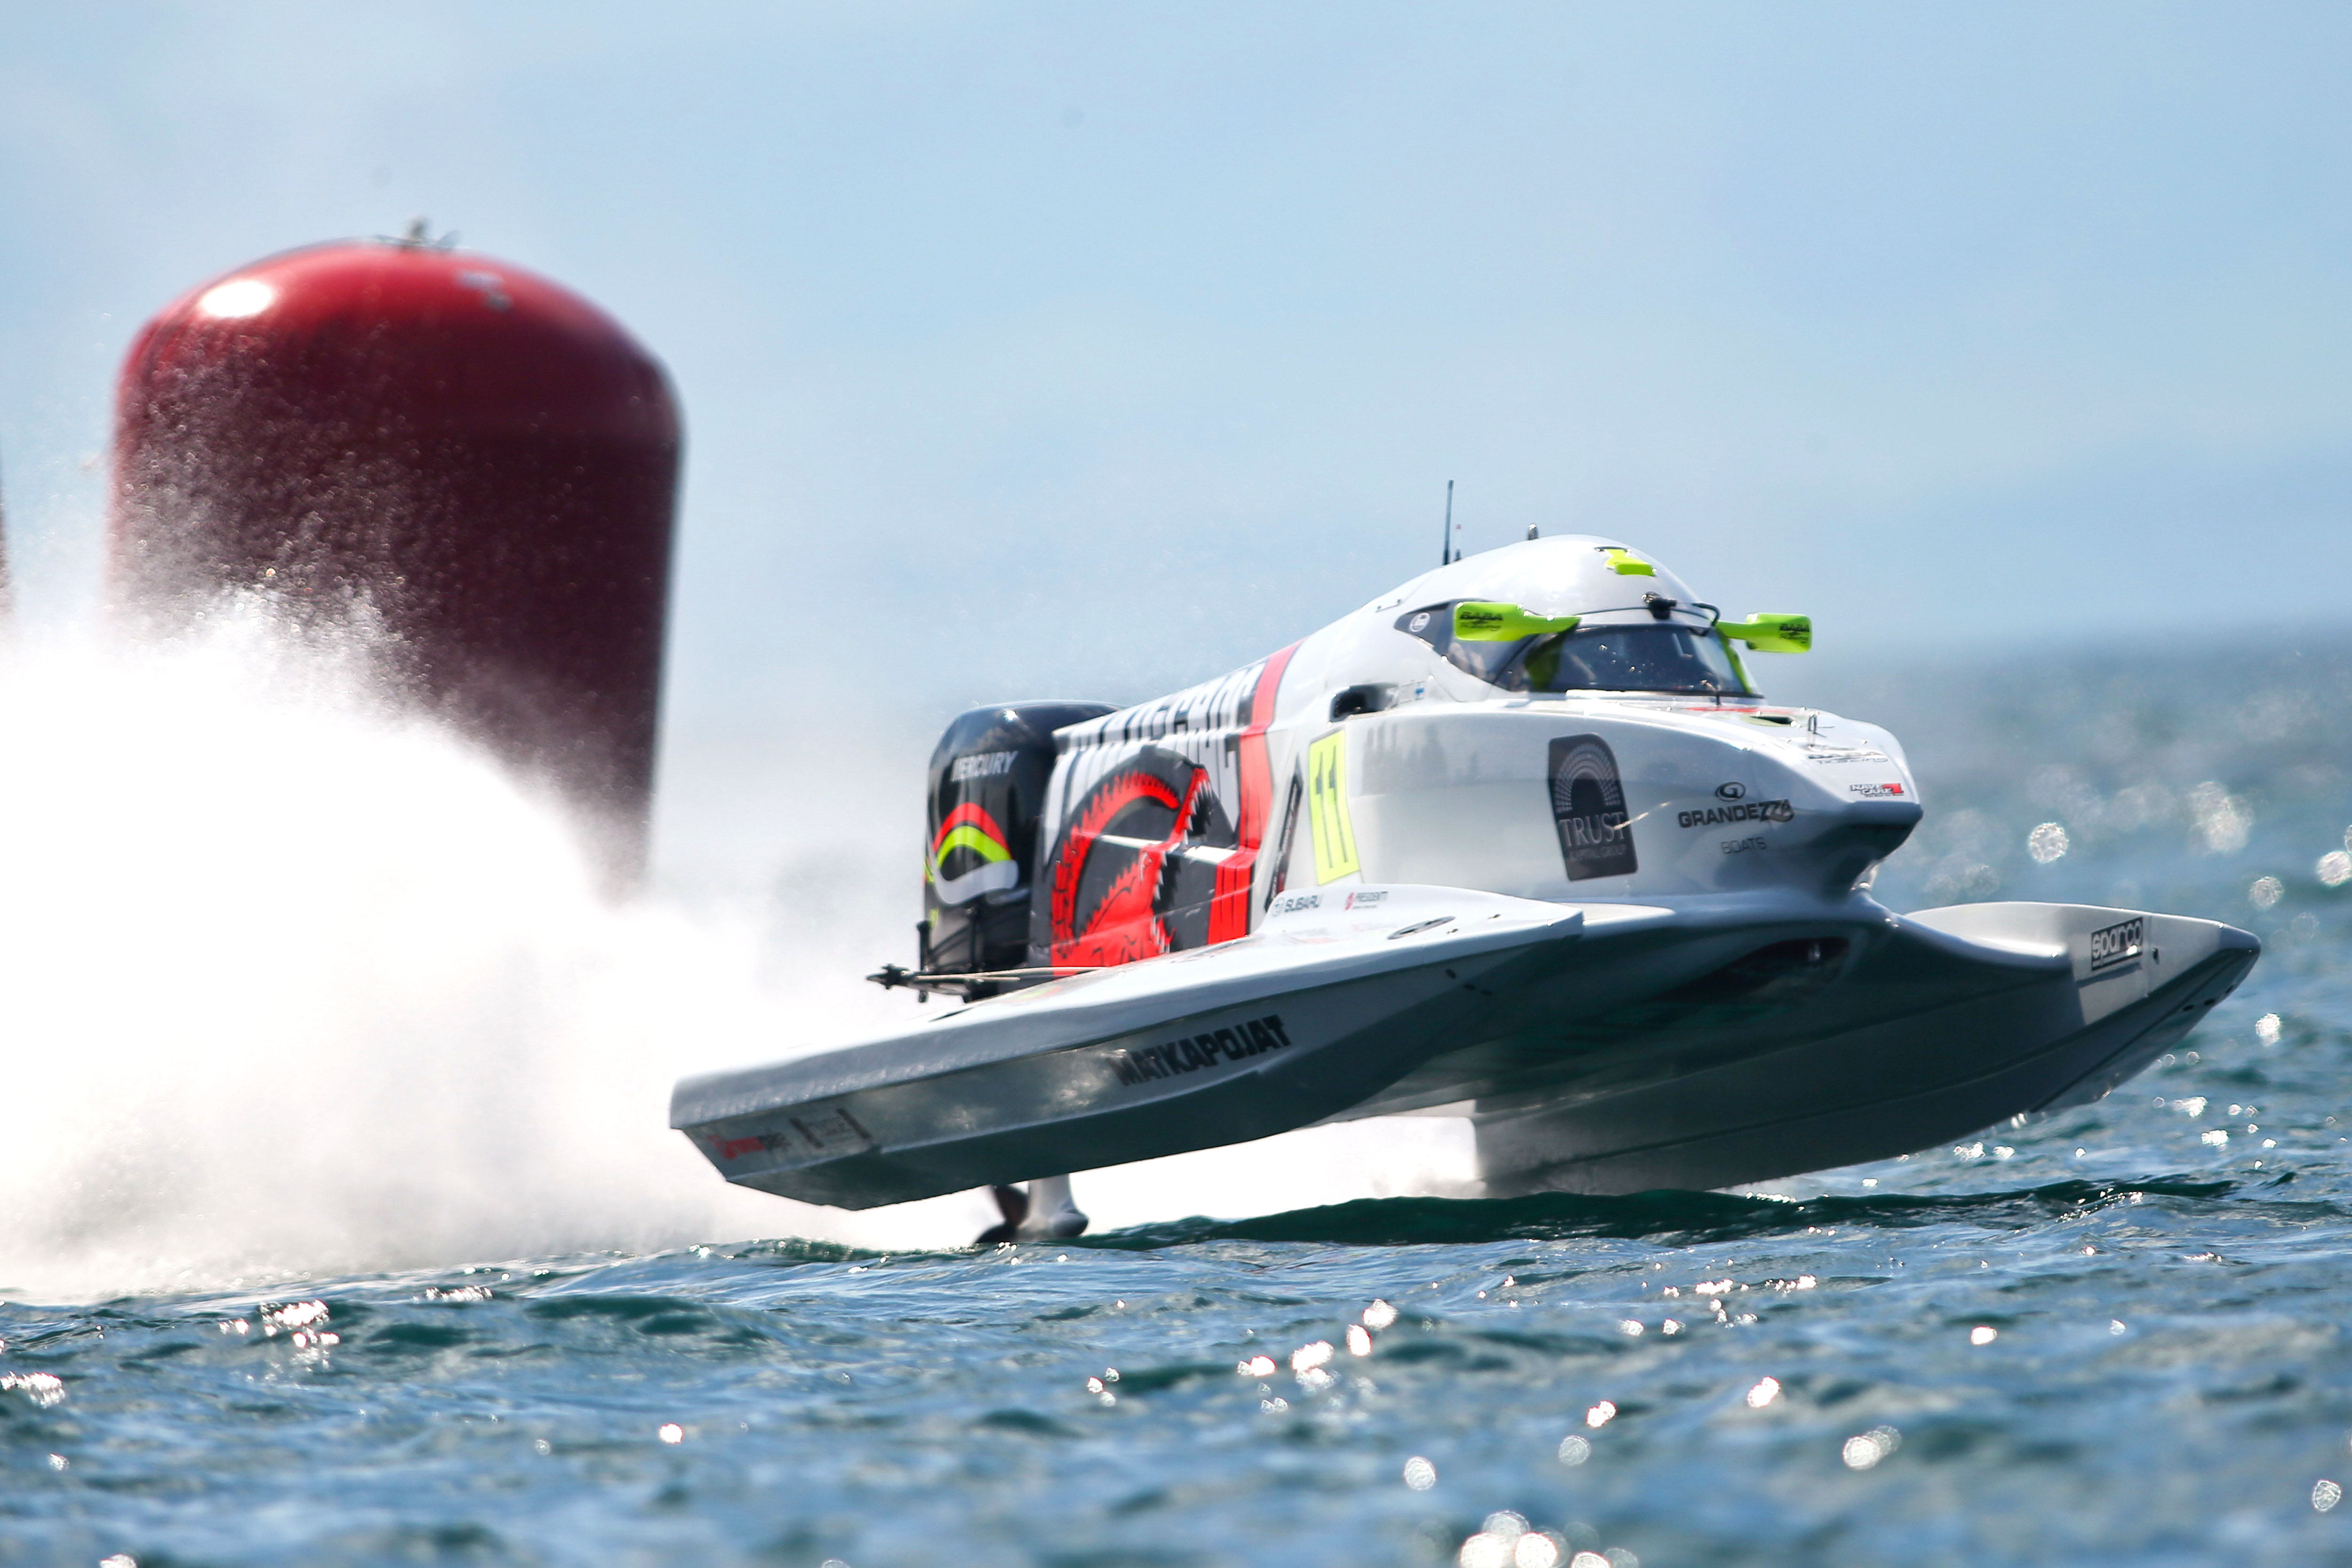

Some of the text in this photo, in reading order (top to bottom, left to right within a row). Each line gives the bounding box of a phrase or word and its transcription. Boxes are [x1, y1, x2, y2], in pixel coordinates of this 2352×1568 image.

[950, 751, 1019, 782] MERCURY
[1558, 812, 1625, 847] TRUST
[1720, 836, 1767, 854] BOATS
